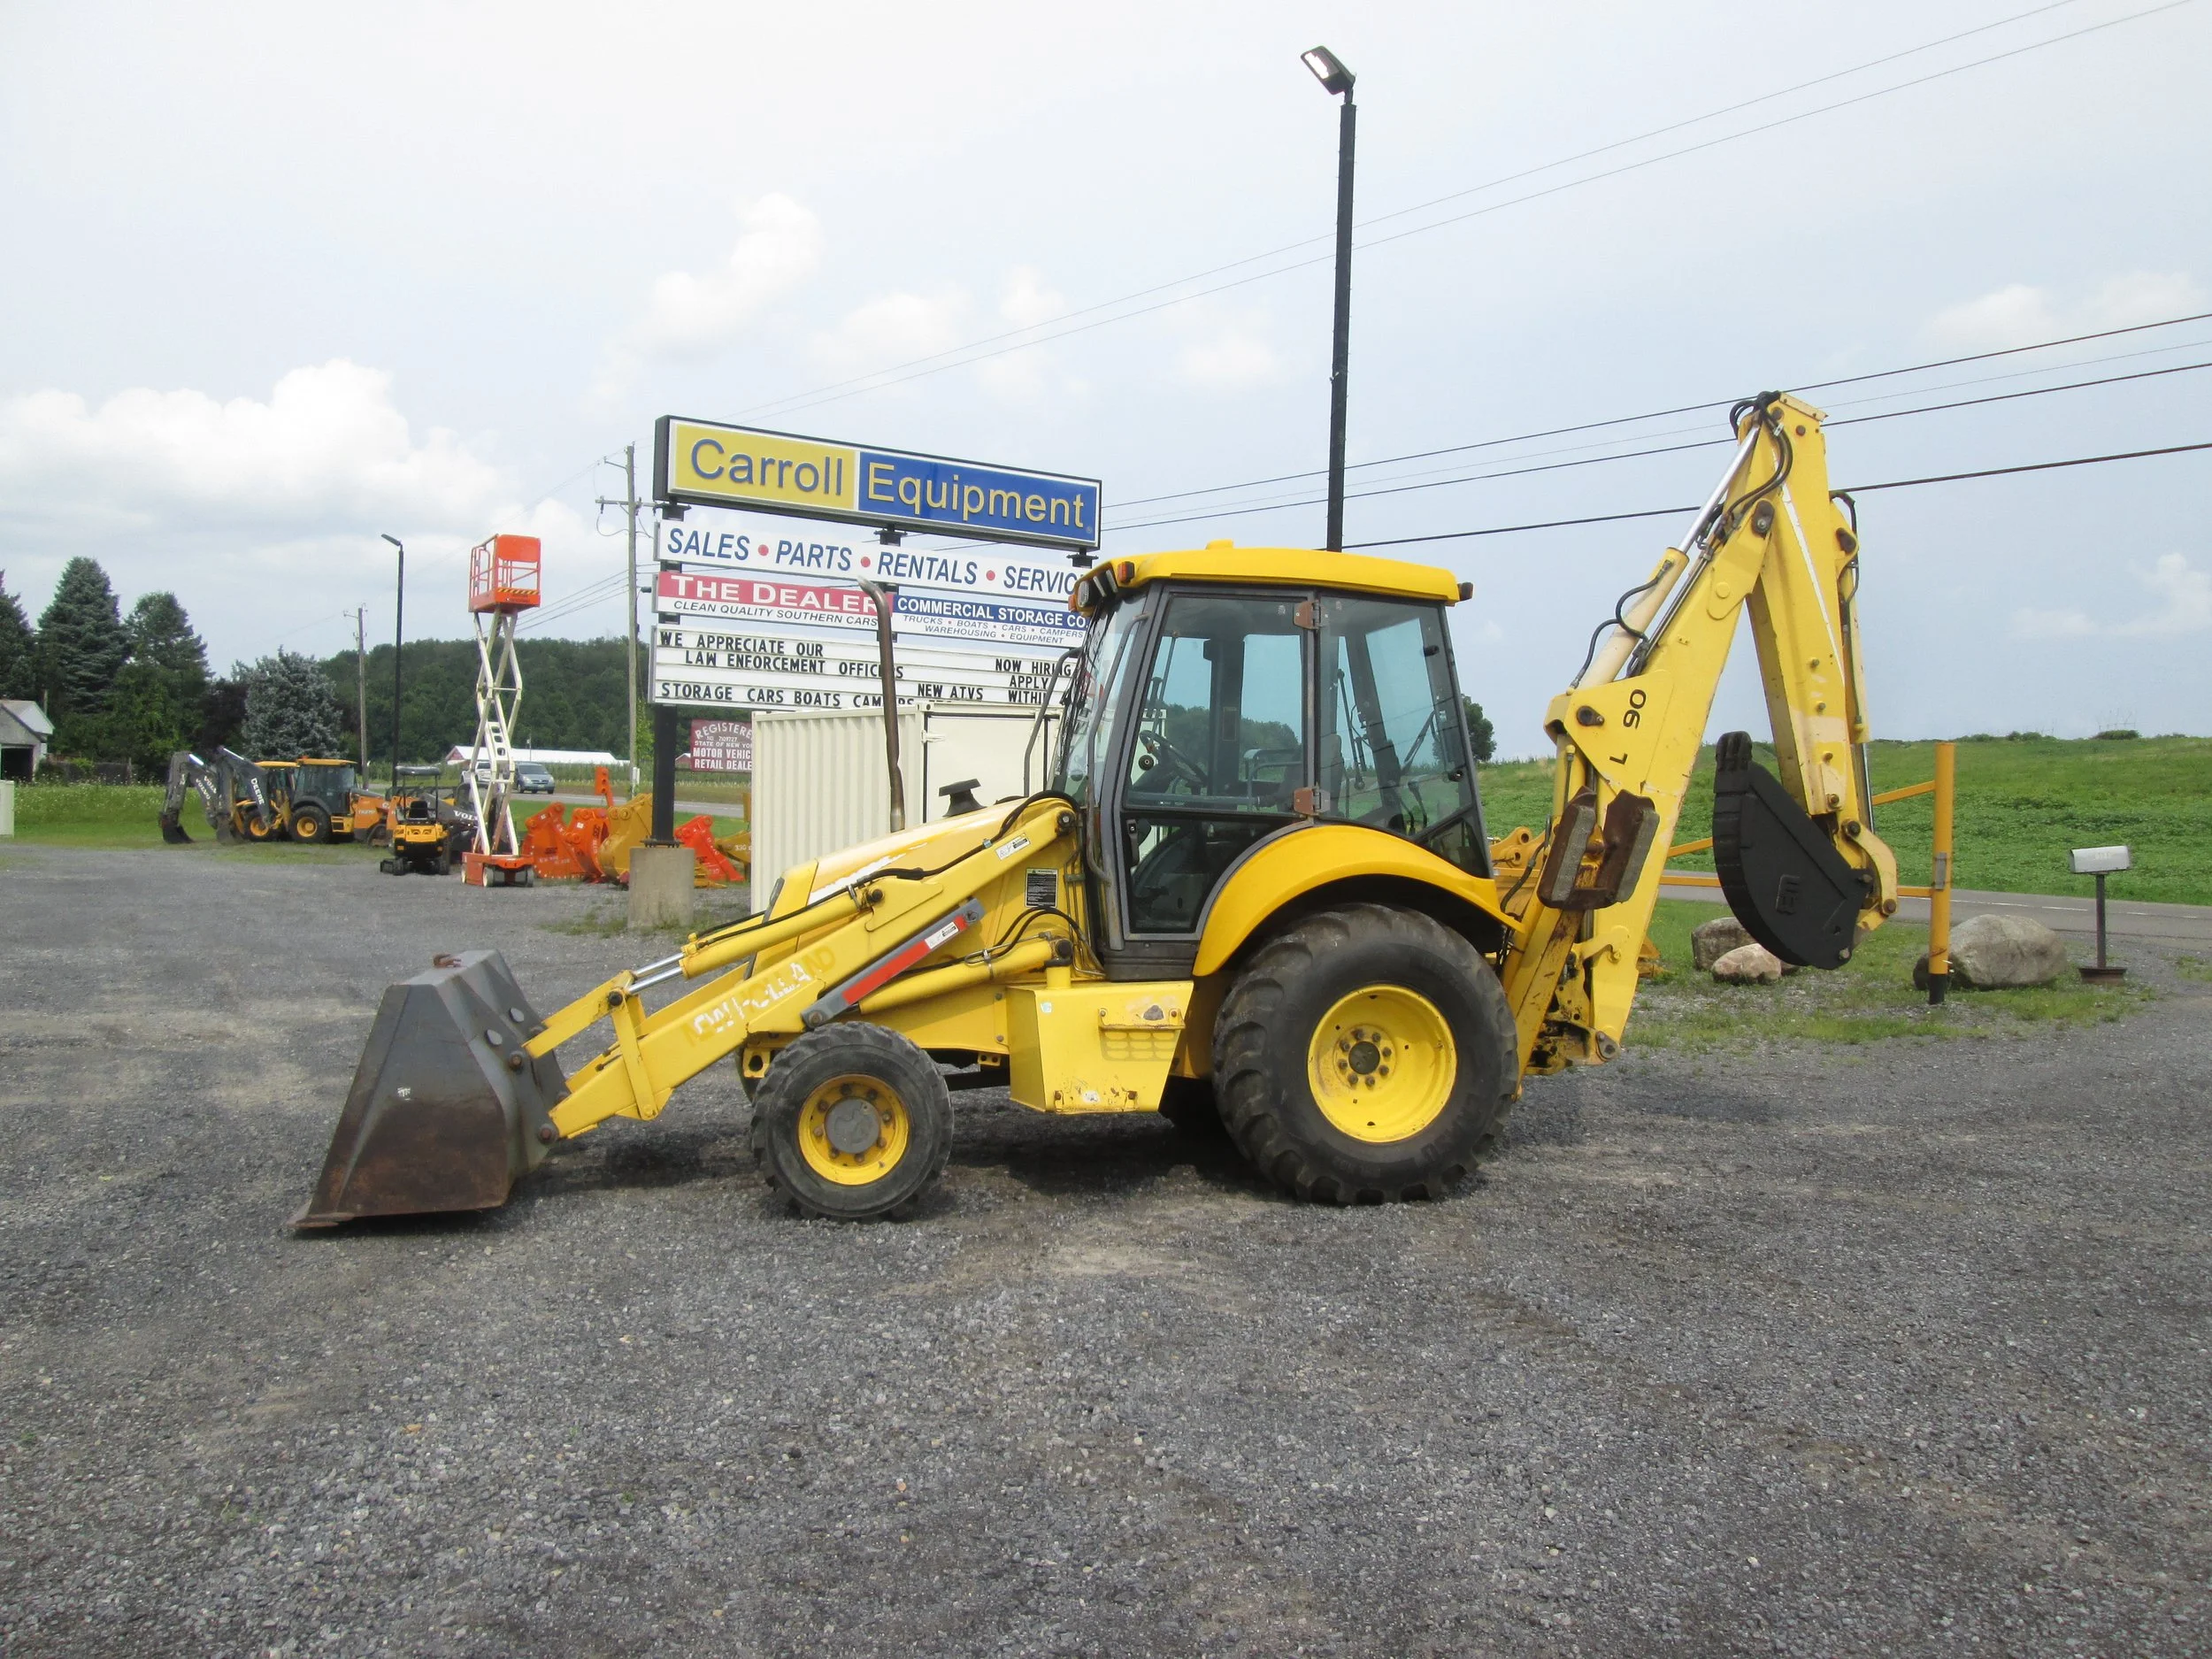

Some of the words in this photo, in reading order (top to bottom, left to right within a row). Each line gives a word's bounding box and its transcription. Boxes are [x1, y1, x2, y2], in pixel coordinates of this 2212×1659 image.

[691, 438, 843, 495] Carroll
[868, 462, 1084, 527] Equipment
[667, 527, 749, 561] SALES
[775, 540, 852, 571] PARTS
[877, 551, 978, 585] RENTALS
[1003, 565, 1083, 595] SERVIC
[671, 575, 740, 602] THE
[673, 601, 718, 612] CLEAN
[720, 604, 773, 617] QUALITY
[776, 610, 842, 623] SOUTHERN
[846, 615, 878, 626] CARS
[897, 597, 995, 619] COMMERCIAL
[998, 607, 1064, 626] STORAGE
[903, 614, 943, 626] TRUCKS
[956, 619, 988, 629] BOATS
[1002, 624, 1026, 633] CARS
[1039, 627, 1084, 639] CAMPERS
[925, 625, 997, 638] WAREHOUSING
[1009, 634, 1064, 644] EQUIPMENT
[660, 631, 683, 647] WE
[696, 634, 785, 655] APPRECIATE
[796, 641, 824, 657] OUR
[686, 650, 717, 667] LAW
[727, 654, 826, 673] ENFORCEMENT
[839, 662, 903, 679] OFFICS
[995, 658, 1022, 672] NOW
[1032, 661, 1071, 677] HIRIG
[661, 682, 733, 701] STORAGE
[747, 688, 784, 703] CARS
[794, 691, 841, 707] BOATS
[918, 683, 943, 698] NEW
[950, 686, 983, 701] ATVS
[1010, 675, 1048, 689] APPLY
[695, 722, 752, 740] REGISTERE
[1609, 753, 1628, 765] L
[1623, 688, 1647, 729] 90
[693, 747, 723, 758] MOTOR
[726, 749, 752, 759] VEHIC
[694, 758, 724, 770] RETAIL
[250, 777, 265, 805] DEERE
[452, 810, 476, 820] VOL
